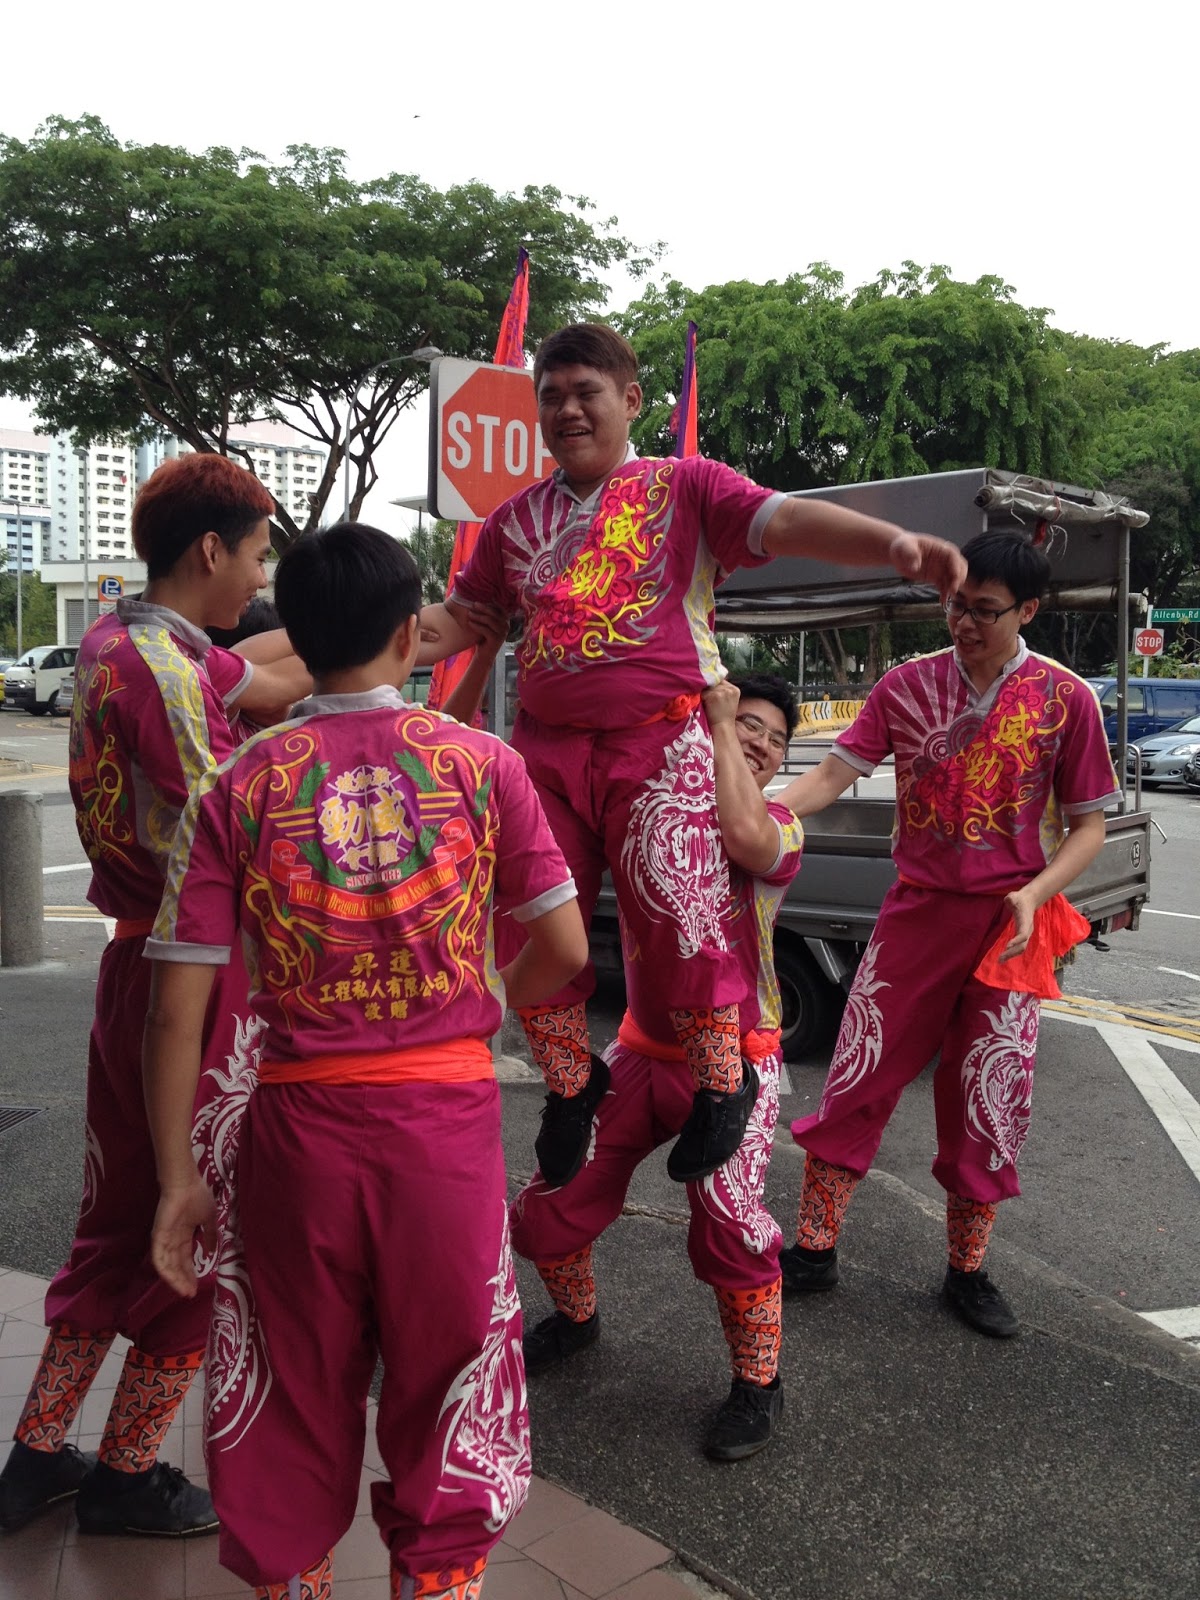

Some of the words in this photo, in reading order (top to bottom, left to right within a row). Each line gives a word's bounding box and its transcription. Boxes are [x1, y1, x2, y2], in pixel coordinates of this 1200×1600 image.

[447, 410, 553, 479] STOP
[1154, 610, 1186, 620] Allenby
[1189, 610, 1199, 619] Rd
[1137, 637, 1162, 648] STOP
[328, 892, 359, 917] Dragon
[360, 899, 368, 916] &
[369, 898, 385, 914] Lion
[407, 867, 454, 901] Association
